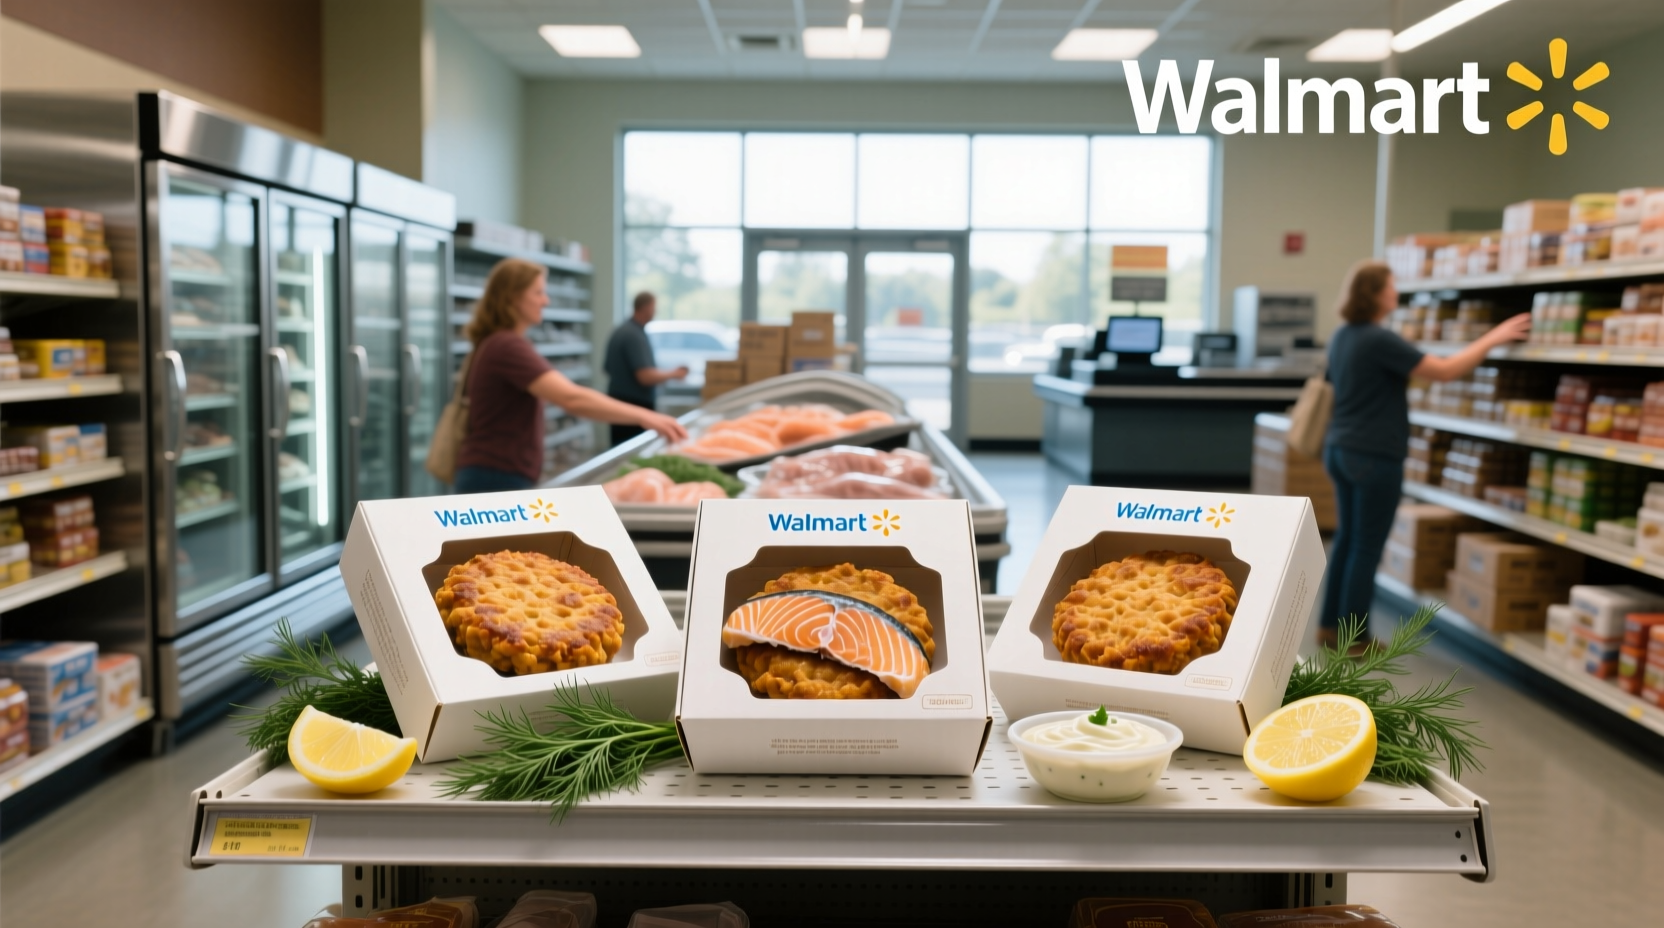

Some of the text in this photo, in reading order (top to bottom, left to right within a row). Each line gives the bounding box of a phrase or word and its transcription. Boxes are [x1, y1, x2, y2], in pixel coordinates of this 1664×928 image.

[433, 503, 529, 528] Walmart
[768, 512, 868, 533] Walmart
[1116, 501, 1203, 524] Walmart
